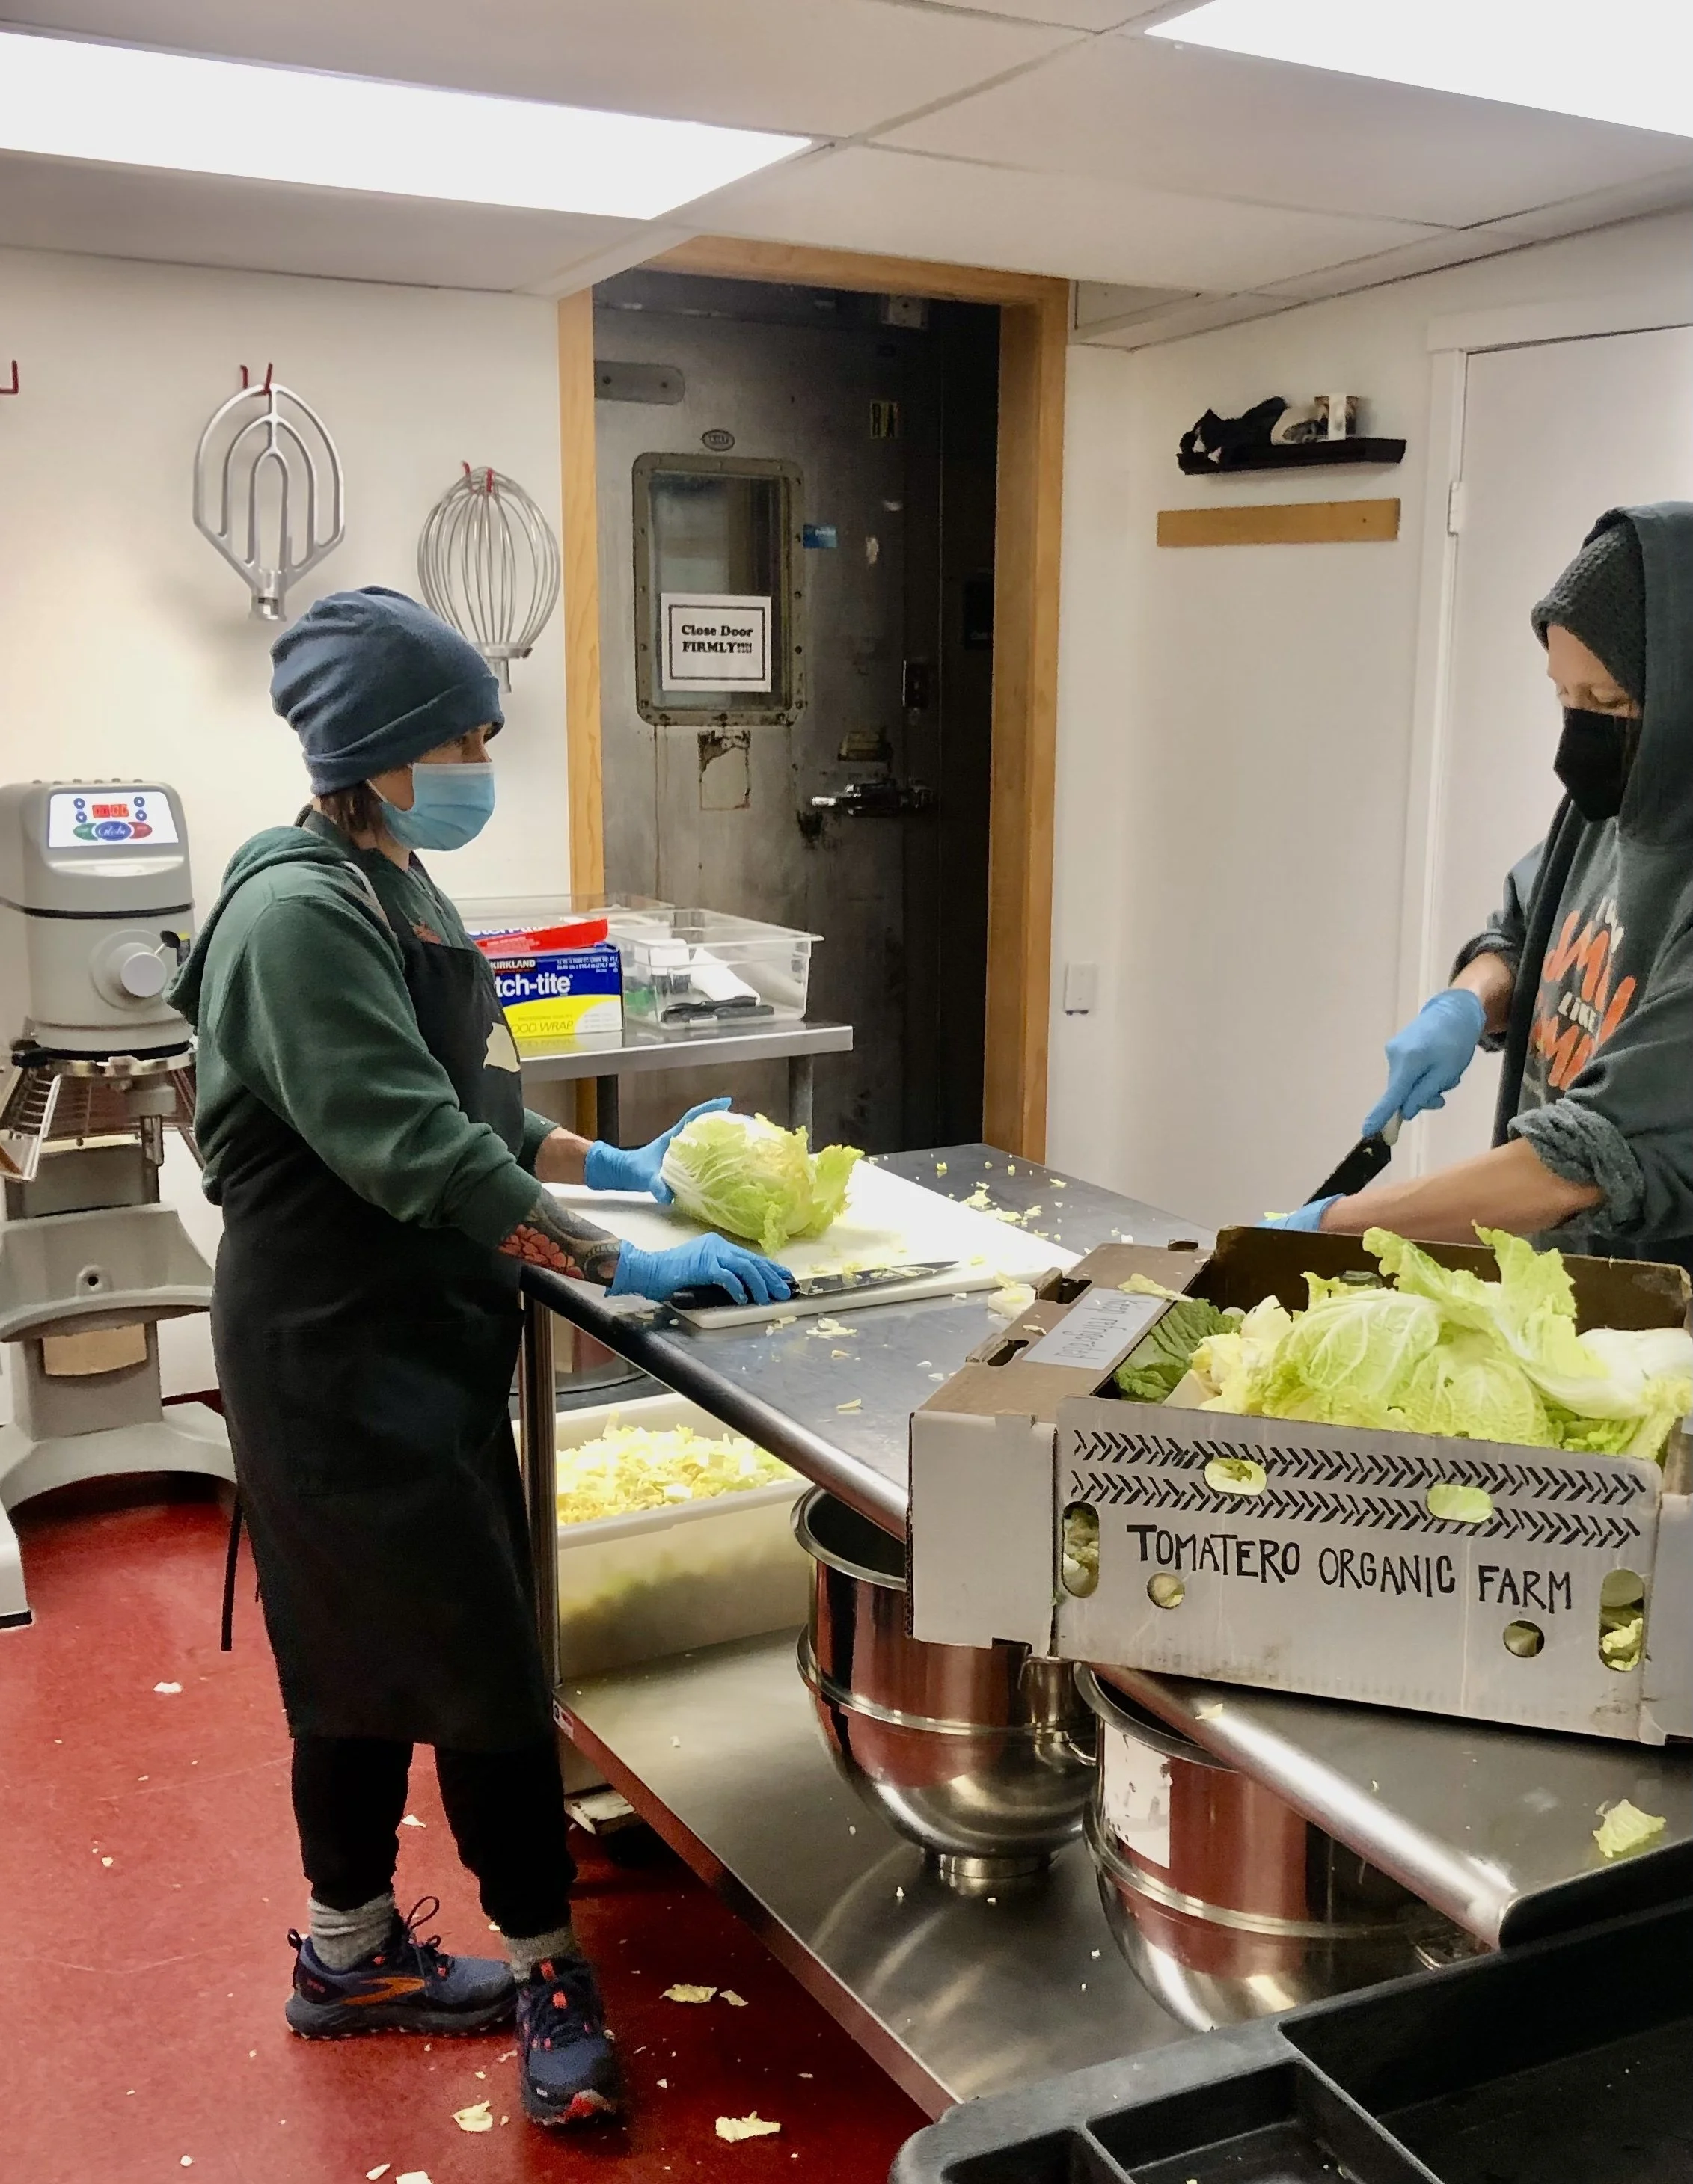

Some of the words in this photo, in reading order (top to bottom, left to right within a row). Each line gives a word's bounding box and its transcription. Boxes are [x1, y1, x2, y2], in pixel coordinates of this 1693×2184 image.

[682, 624, 717, 636] Close
[720, 625, 754, 637] Door
[490, 959, 536, 970] KIRKLAND
[494, 972, 572, 998] tch-tite
[510, 1022, 537, 1034] OOD
[540, 1021, 574, 1032] WRAP
[1126, 1524, 1300, 1583] TOMATERO
[1318, 1547, 1456, 1598] ORGANIC
[1478, 1565, 1572, 1614] FARM
